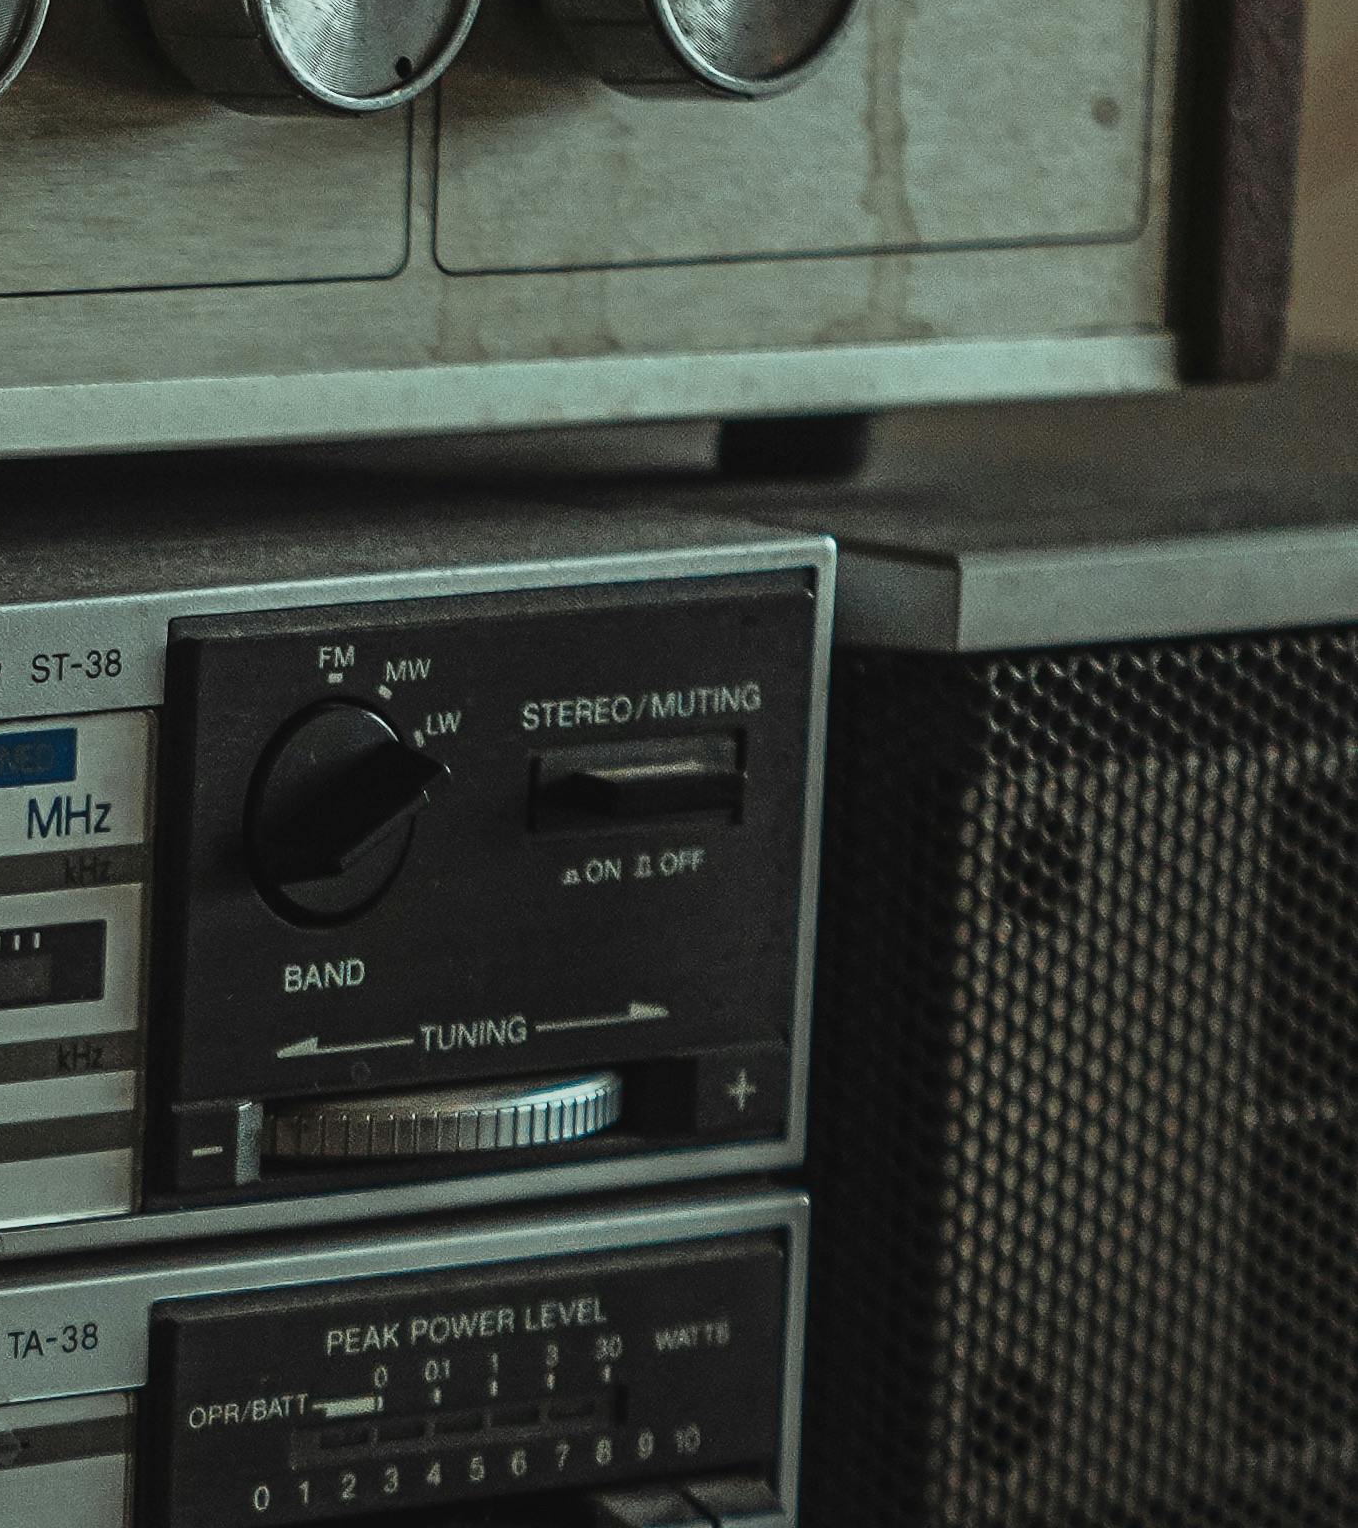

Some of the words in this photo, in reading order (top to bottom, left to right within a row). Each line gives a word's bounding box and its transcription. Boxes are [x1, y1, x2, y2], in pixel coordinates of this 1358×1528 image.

[31, 649, 122, 684] ST-38
[319, 647, 355, 669] FM
[385, 659, 432, 683] MW
[426, 712, 462, 735] LW
[521, 683, 761, 730] STEREO/MUTING
[27, 796, 111, 840] MHz
[63, 855, 111, 884] kHz
[586, 859, 621, 883] ON
[660, 849, 705, 876] OFF
[283, 960, 365, 994] BAND
[420, 1016, 527, 1052] TUNING
[58, 1043, 104, 1071] kHz
[9, 1323, 99, 1361] TA-38
[326, 1323, 399, 1356] PEAK
[410, 1308, 515, 1344] POWER
[524, 1297, 607, 1329] LEVEL
[595, 1337, 623, 1360] 30
[188, 1392, 309, 1430] OPR/BATT
[254, 1487, 269, 1511] 0
[299, 1480, 309, 1503] 1
[342, 1474, 356, 1500] 2
[384, 1468, 399, 1493] 3
[426, 1462, 441, 1487] 4
[470, 1456, 484, 1482] 5
[511, 1449, 527, 1474] 6
[556, 1444, 570, 1469] 7
[596, 1438, 612, 1464] 8
[638, 1432, 654, 1458] 9
[676, 1425, 700, 1454] 10
